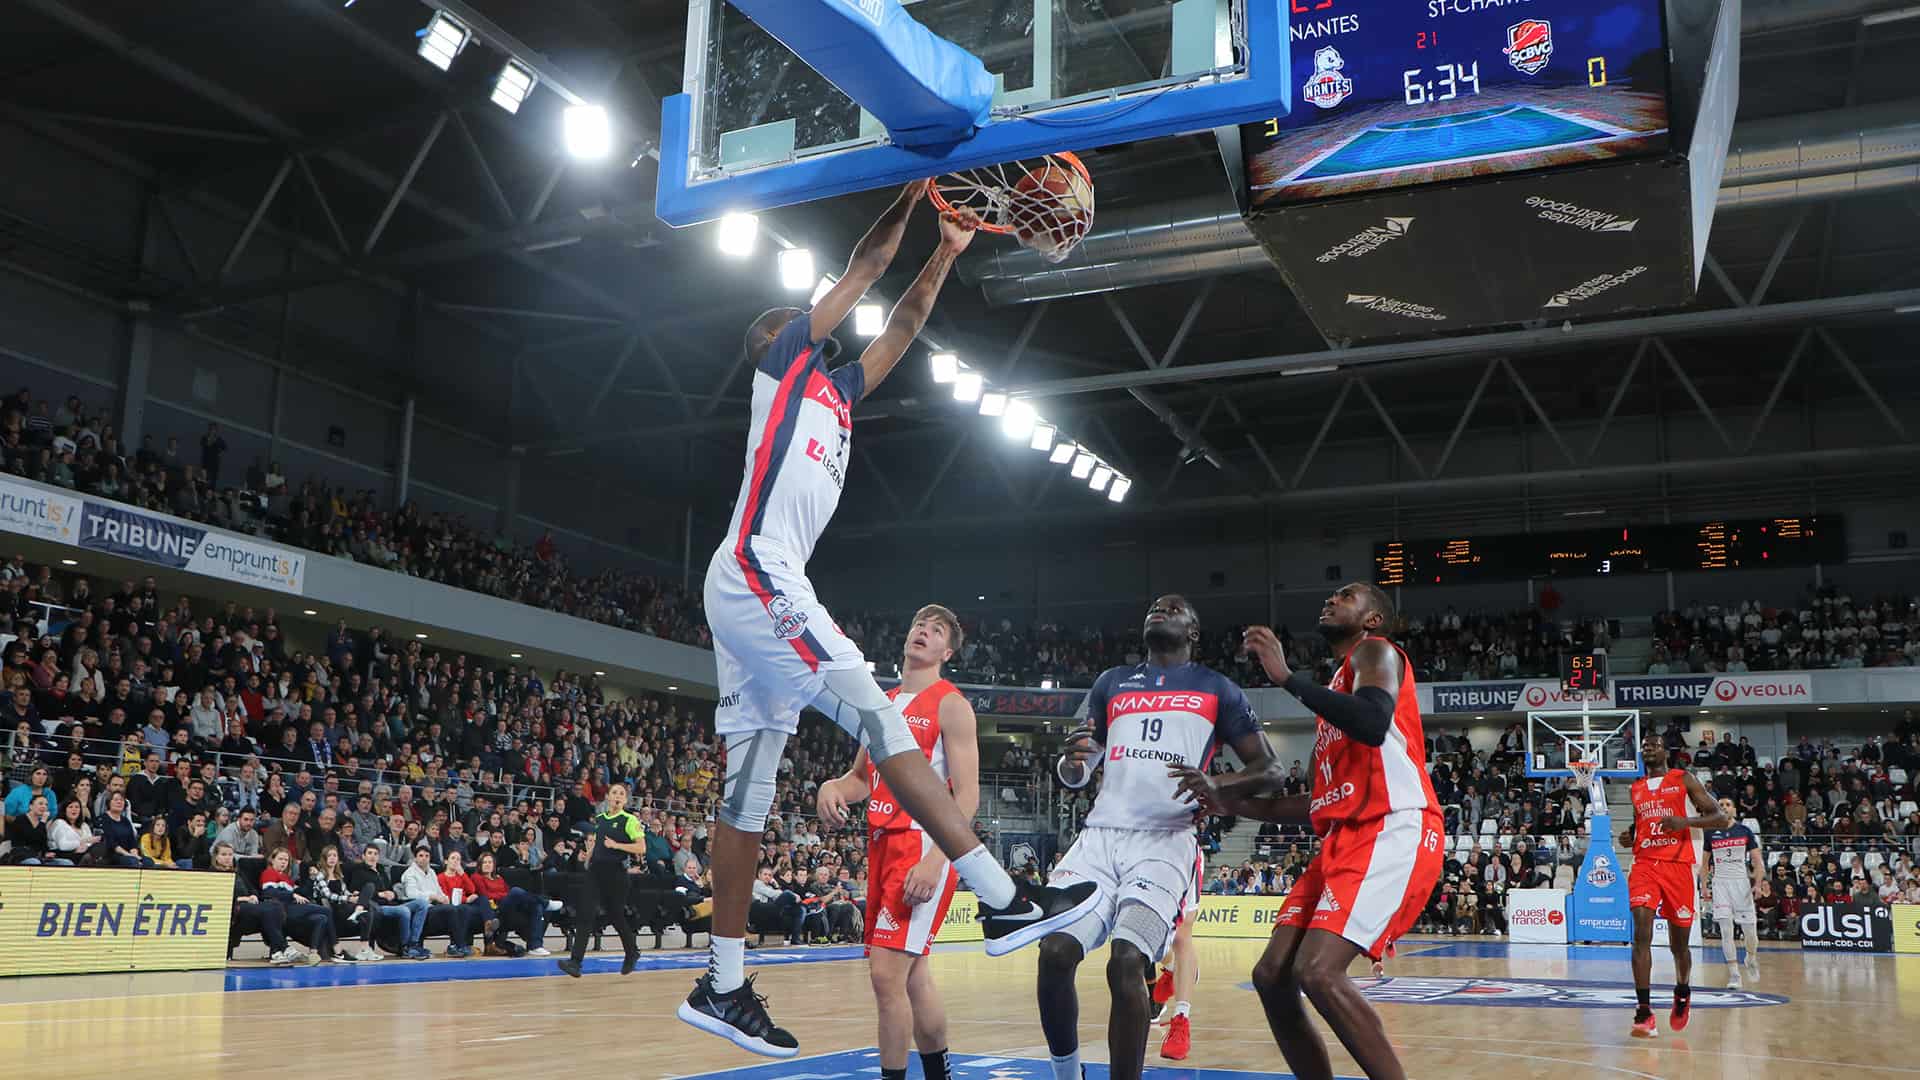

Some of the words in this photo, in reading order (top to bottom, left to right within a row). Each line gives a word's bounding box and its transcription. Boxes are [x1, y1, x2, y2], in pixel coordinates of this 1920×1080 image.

[1290, 14, 1360, 42] NANTES
[1416, 31, 1439, 50] 21
[1588, 56, 1607, 88] 0
[1306, 80, 1350, 98] NANTES
[1403, 60, 1480, 105] 6:34
[1538, 210, 1606, 231] Nantes
[1, 493, 75, 537] runtis!
[88, 514, 196, 558] TRIBUNE
[1569, 669, 1597, 687] 21
[1438, 690, 1518, 707] TRIBUNE
[1620, 684, 1706, 701] TRIBUNE
[1740, 683, 1807, 698] VEOLIA
[1112, 694, 1203, 717] NANTES
[1140, 718, 1163, 742] 19
[869, 799, 893, 814] SIO
[36, 902, 125, 937] BIEN
[132, 893, 213, 936] ÊTRE
[1195, 905, 1239, 923] ANTÉ
[1254, 909, 1279, 924] BIE
[1512, 914, 1547, 926] france
[1516, 908, 1547, 918] ouest
[1802, 906, 1873, 938] dlsi
